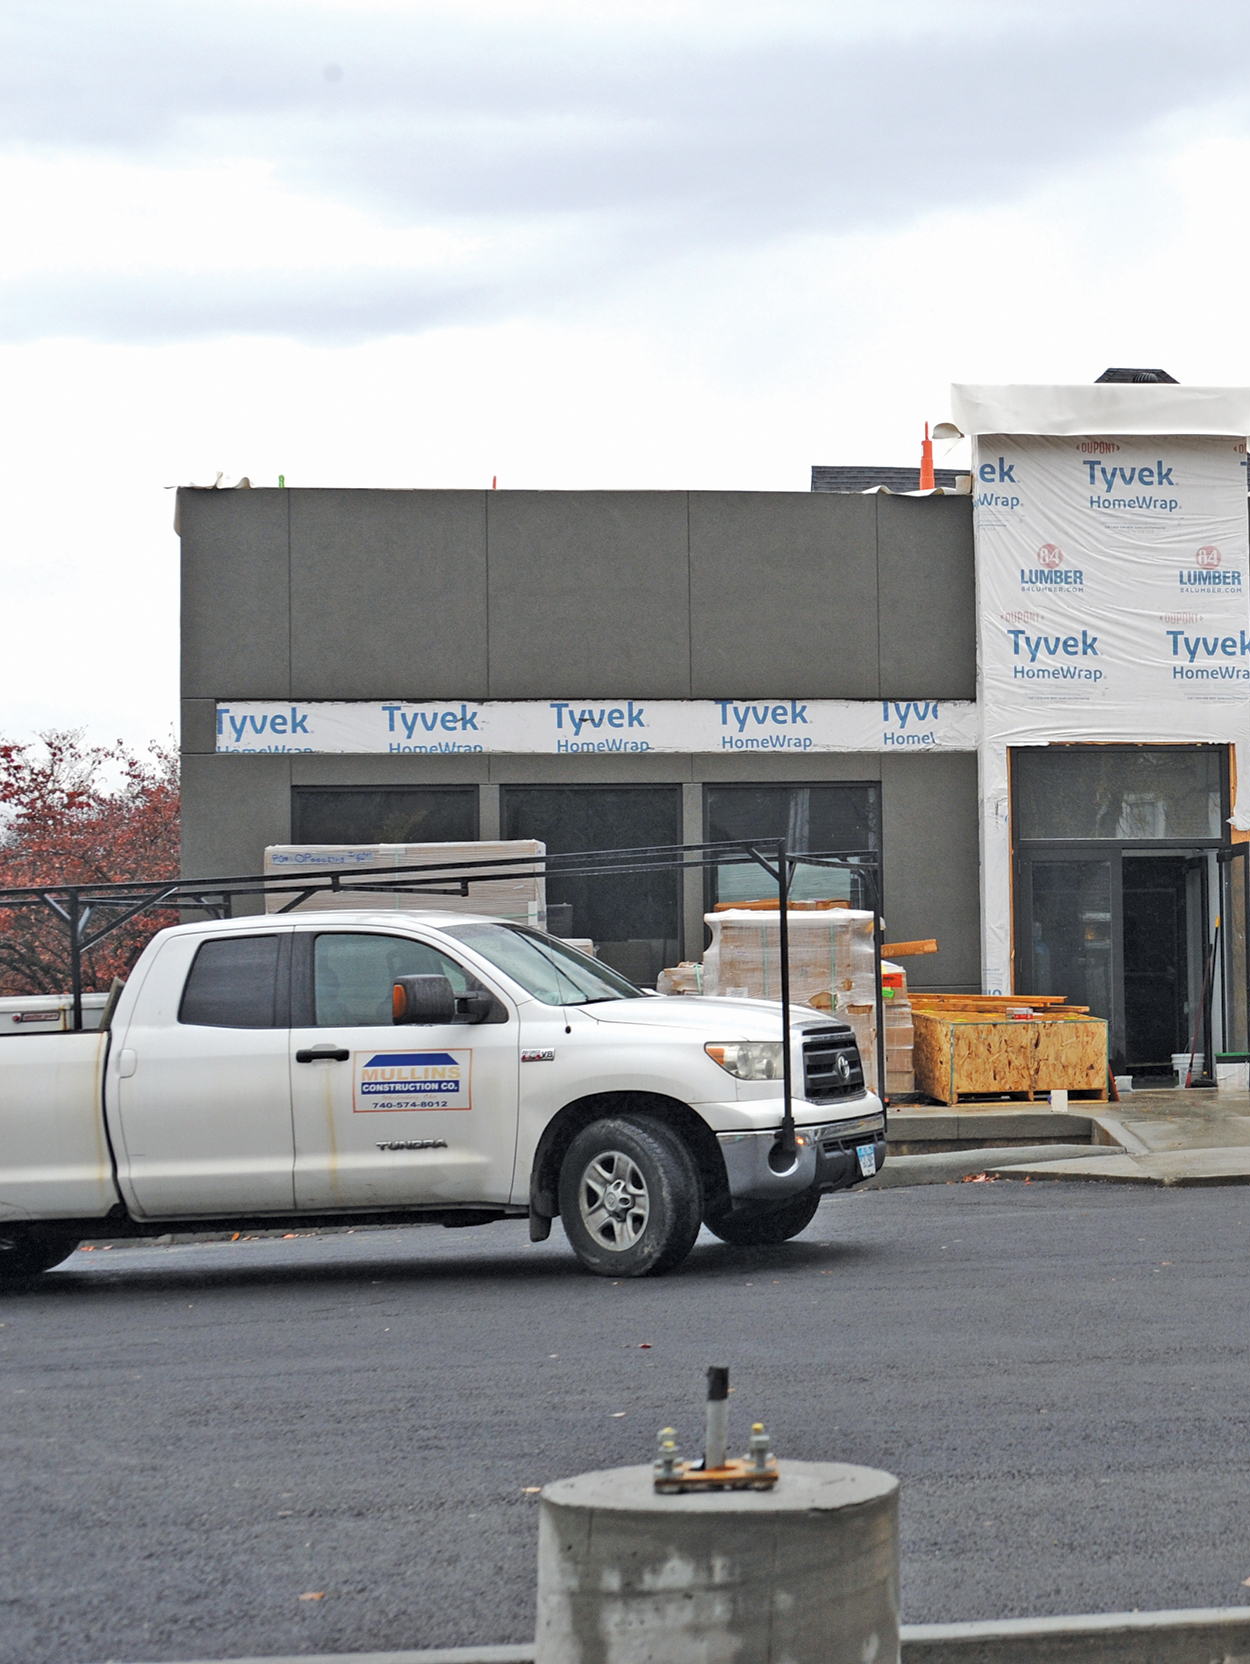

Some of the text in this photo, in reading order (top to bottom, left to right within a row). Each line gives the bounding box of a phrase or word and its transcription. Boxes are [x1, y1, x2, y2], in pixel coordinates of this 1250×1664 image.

[1083, 460, 1175, 493] Tyvek
[1089, 495, 1178, 512] HomeWrap
[1039, 548, 1060, 564] 84
[1198, 549, 1218, 565] 84
[1020, 569, 1083, 585] LUMBER
[1179, 570, 1242, 586] LUMBER
[1007, 630, 1099, 662] Tyvek
[1014, 666, 1103, 682] HomeWrap
[382, 704, 479, 739] Tyvek
[550, 701, 645, 736] Tyvek
[714, 700, 808, 732] Tyvek
[217, 707, 309, 742] Tyvek
[557, 739, 650, 753] HomeWrap
[722, 735, 812, 750] HomeWrap
[362, 1067, 461, 1081] MULLINS
[362, 1082, 458, 1092] CONSTRUCTION CO.
[372, 1101, 448, 1109] 740-574-8012
[376, 1139, 448, 1151] TUNDRA
